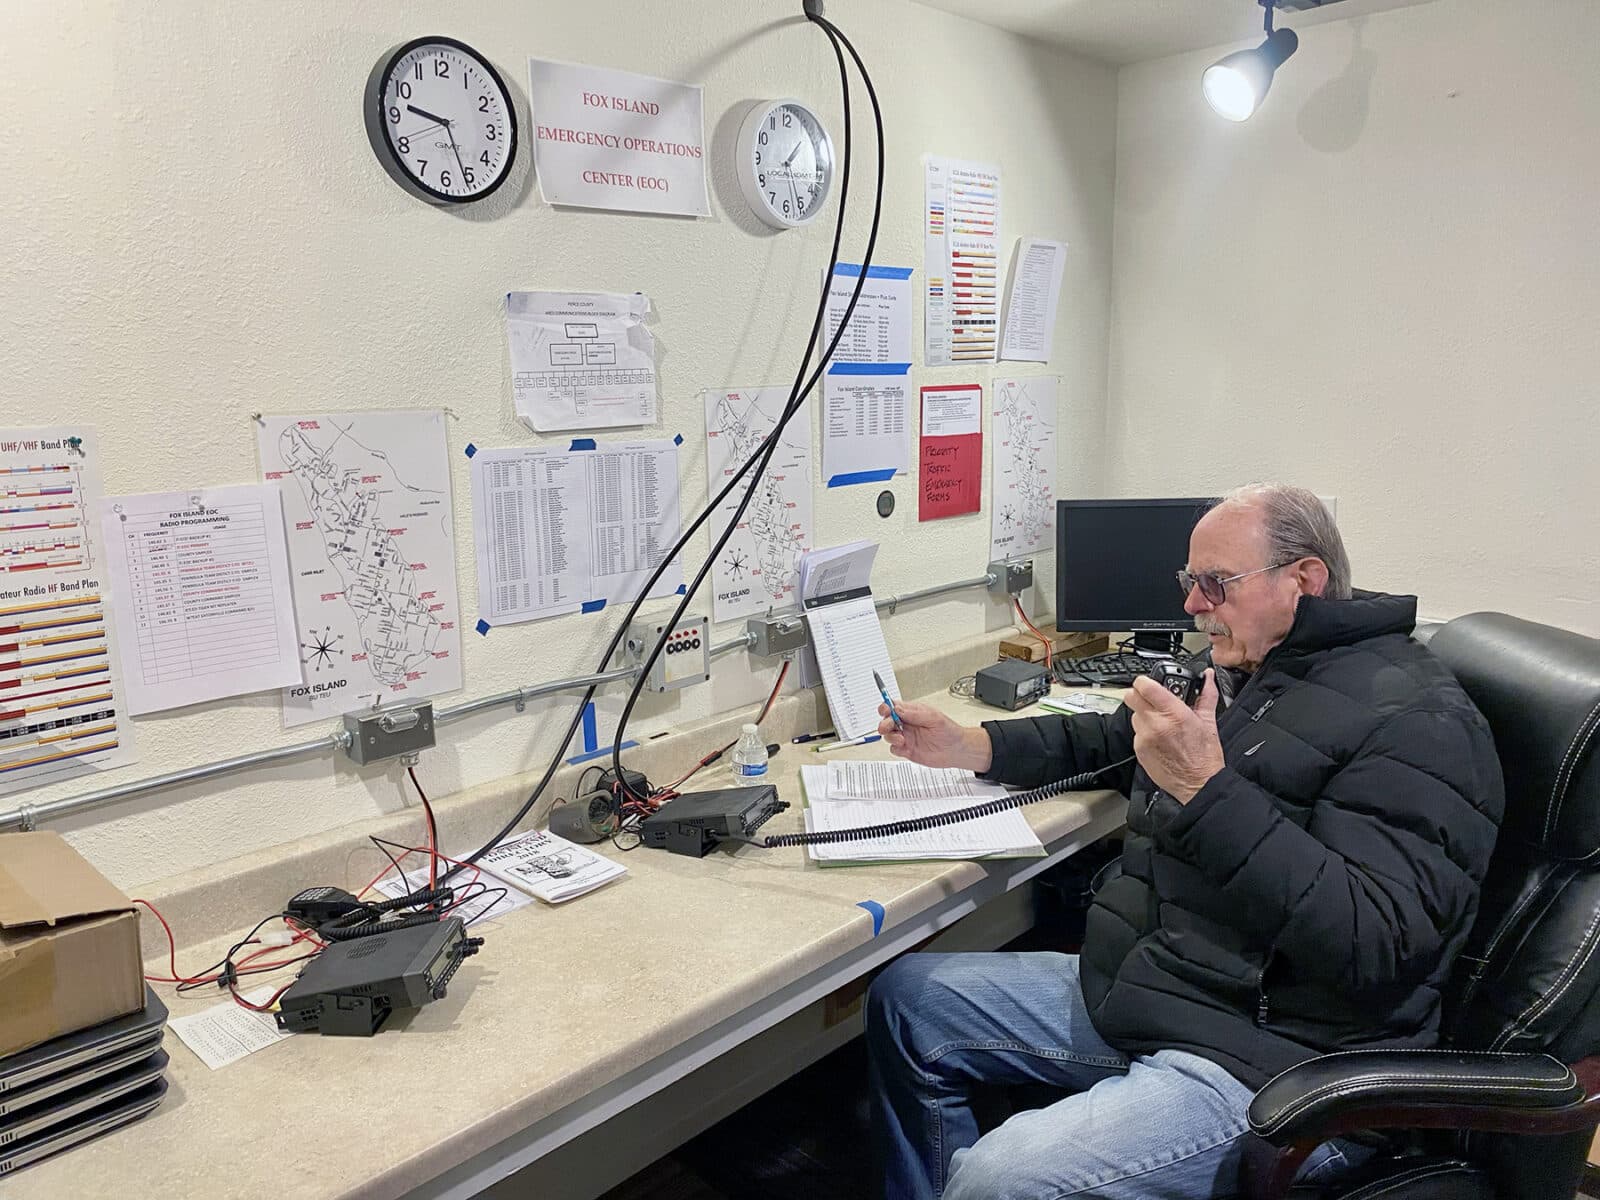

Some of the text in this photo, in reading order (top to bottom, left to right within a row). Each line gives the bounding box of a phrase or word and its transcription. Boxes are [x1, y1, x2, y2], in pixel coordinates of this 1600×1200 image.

[415, 62, 422, 80] 11
[435, 59, 449, 78] 12
[464, 72, 468, 89] 1
[396, 80, 411, 99] 10
[479, 96, 489, 113] 2
[582, 93, 659, 115] FOX ISLAND
[389, 107, 400, 124] 9
[771, 116, 775, 130] 11
[783, 113, 791, 128] 12
[486, 124, 496, 140] 3
[759, 130, 768, 145] 10
[398, 137, 410, 153] 8
[435, 142, 462, 150] GMT
[537, 126, 701, 158] EMERGENCY OPERATIONS
[480, 150, 490, 166] 4
[756, 151, 761, 165] 9
[417, 160, 428, 176] 7
[464, 167, 474, 183] 5
[441, 171, 451, 187] 6
[583, 171, 668, 192] CENTER (EOC)
[759, 174, 765, 187] 8
[808, 184, 814, 195] 4
[769, 192, 776, 205] 7
[783, 200, 790, 213] 6
[0, 441, 38, 454] UHF/VHF
[41, 439, 61, 450] Band
[181, 516, 230, 526] PROGRAMMING
[24, 583, 46, 596] Radio
[48, 584, 57, 593] HF
[60, 581, 80, 591] Band
[82, 579, 98, 589] Plan
[730, 588, 750, 598] ISLAND
[291, 679, 347, 697] FOX ISLAND
[488, 840, 552, 863] DIRECTORY
